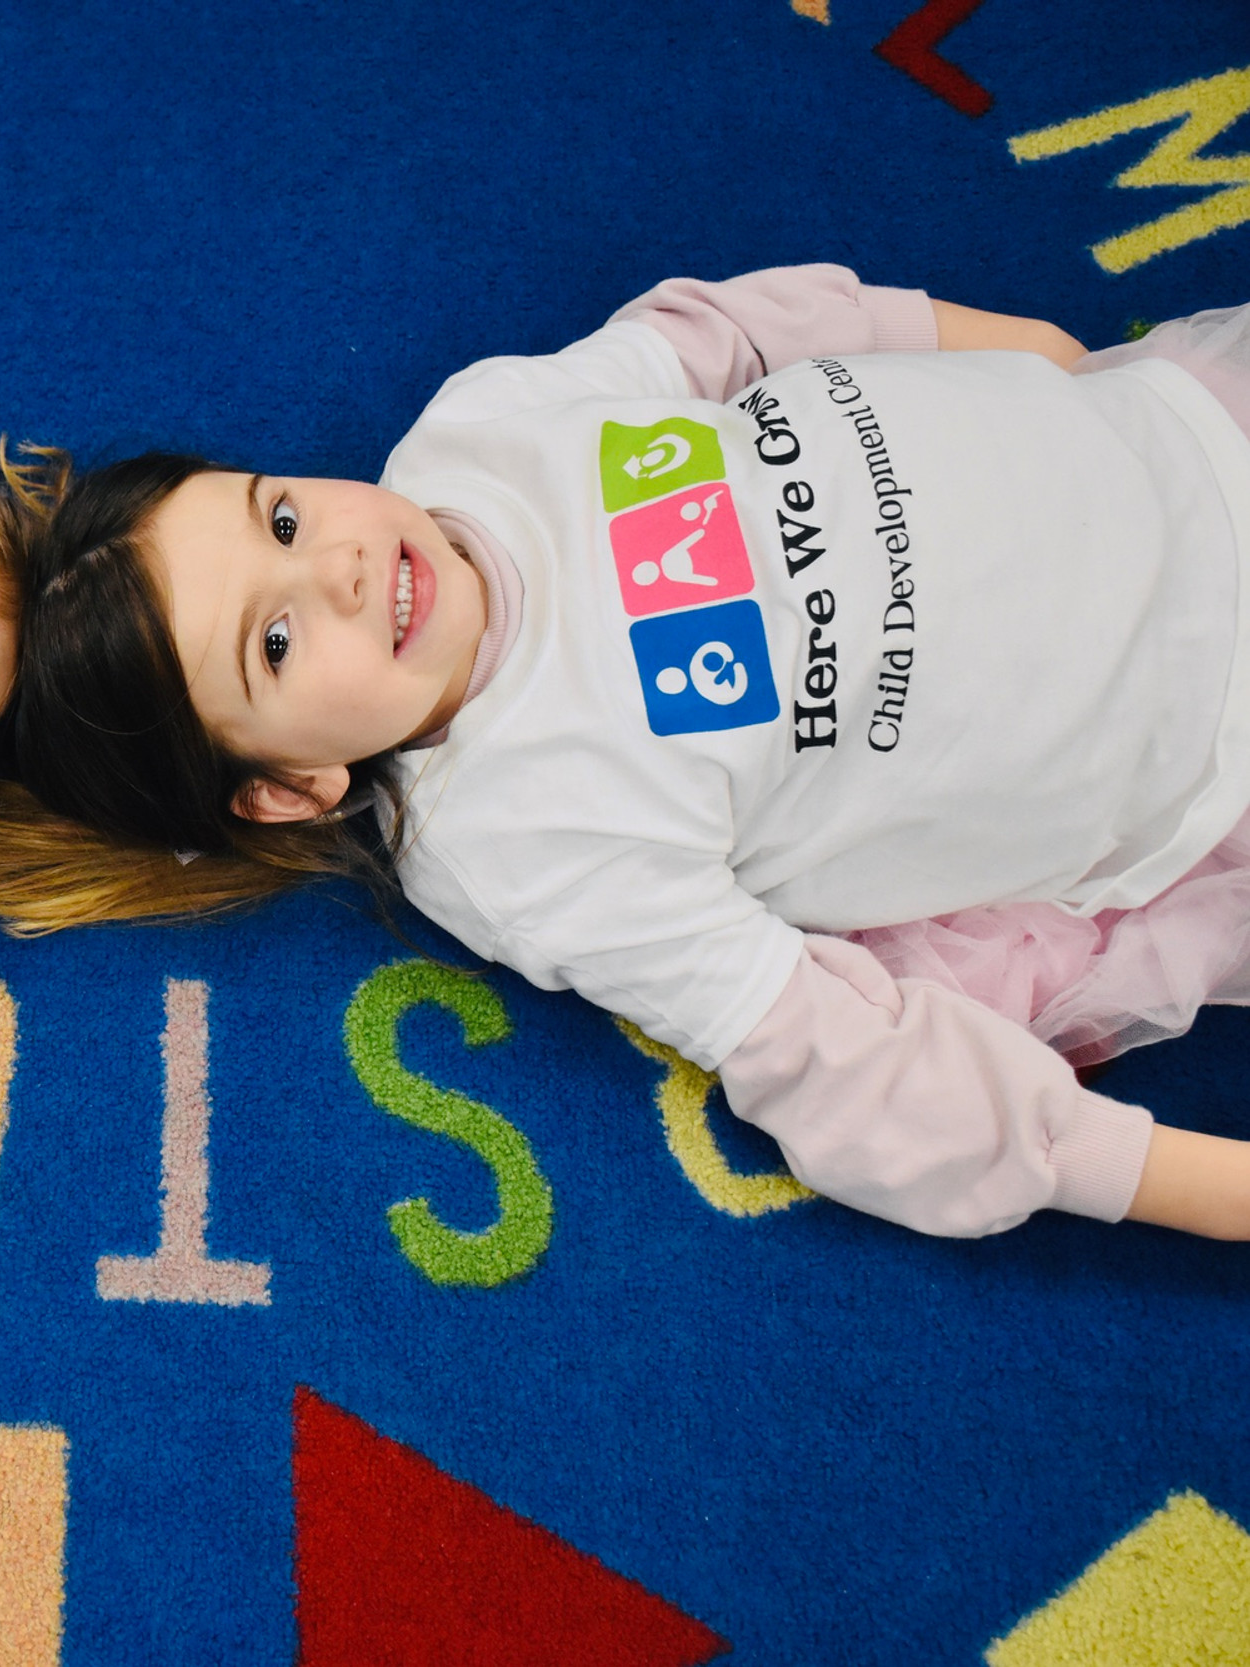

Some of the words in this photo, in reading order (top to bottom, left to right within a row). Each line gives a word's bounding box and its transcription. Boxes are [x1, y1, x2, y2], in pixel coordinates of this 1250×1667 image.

[1006, 62, 1250, 275] M
[810, 357, 862, 405] Cente
[776, 480, 827, 579] We
[841, 404, 915, 634] Development
[794, 588, 838, 754] Here
[867, 647, 915, 753] Child
[95, 975, 272, 1307] T
[343, 958, 554, 1289] S
